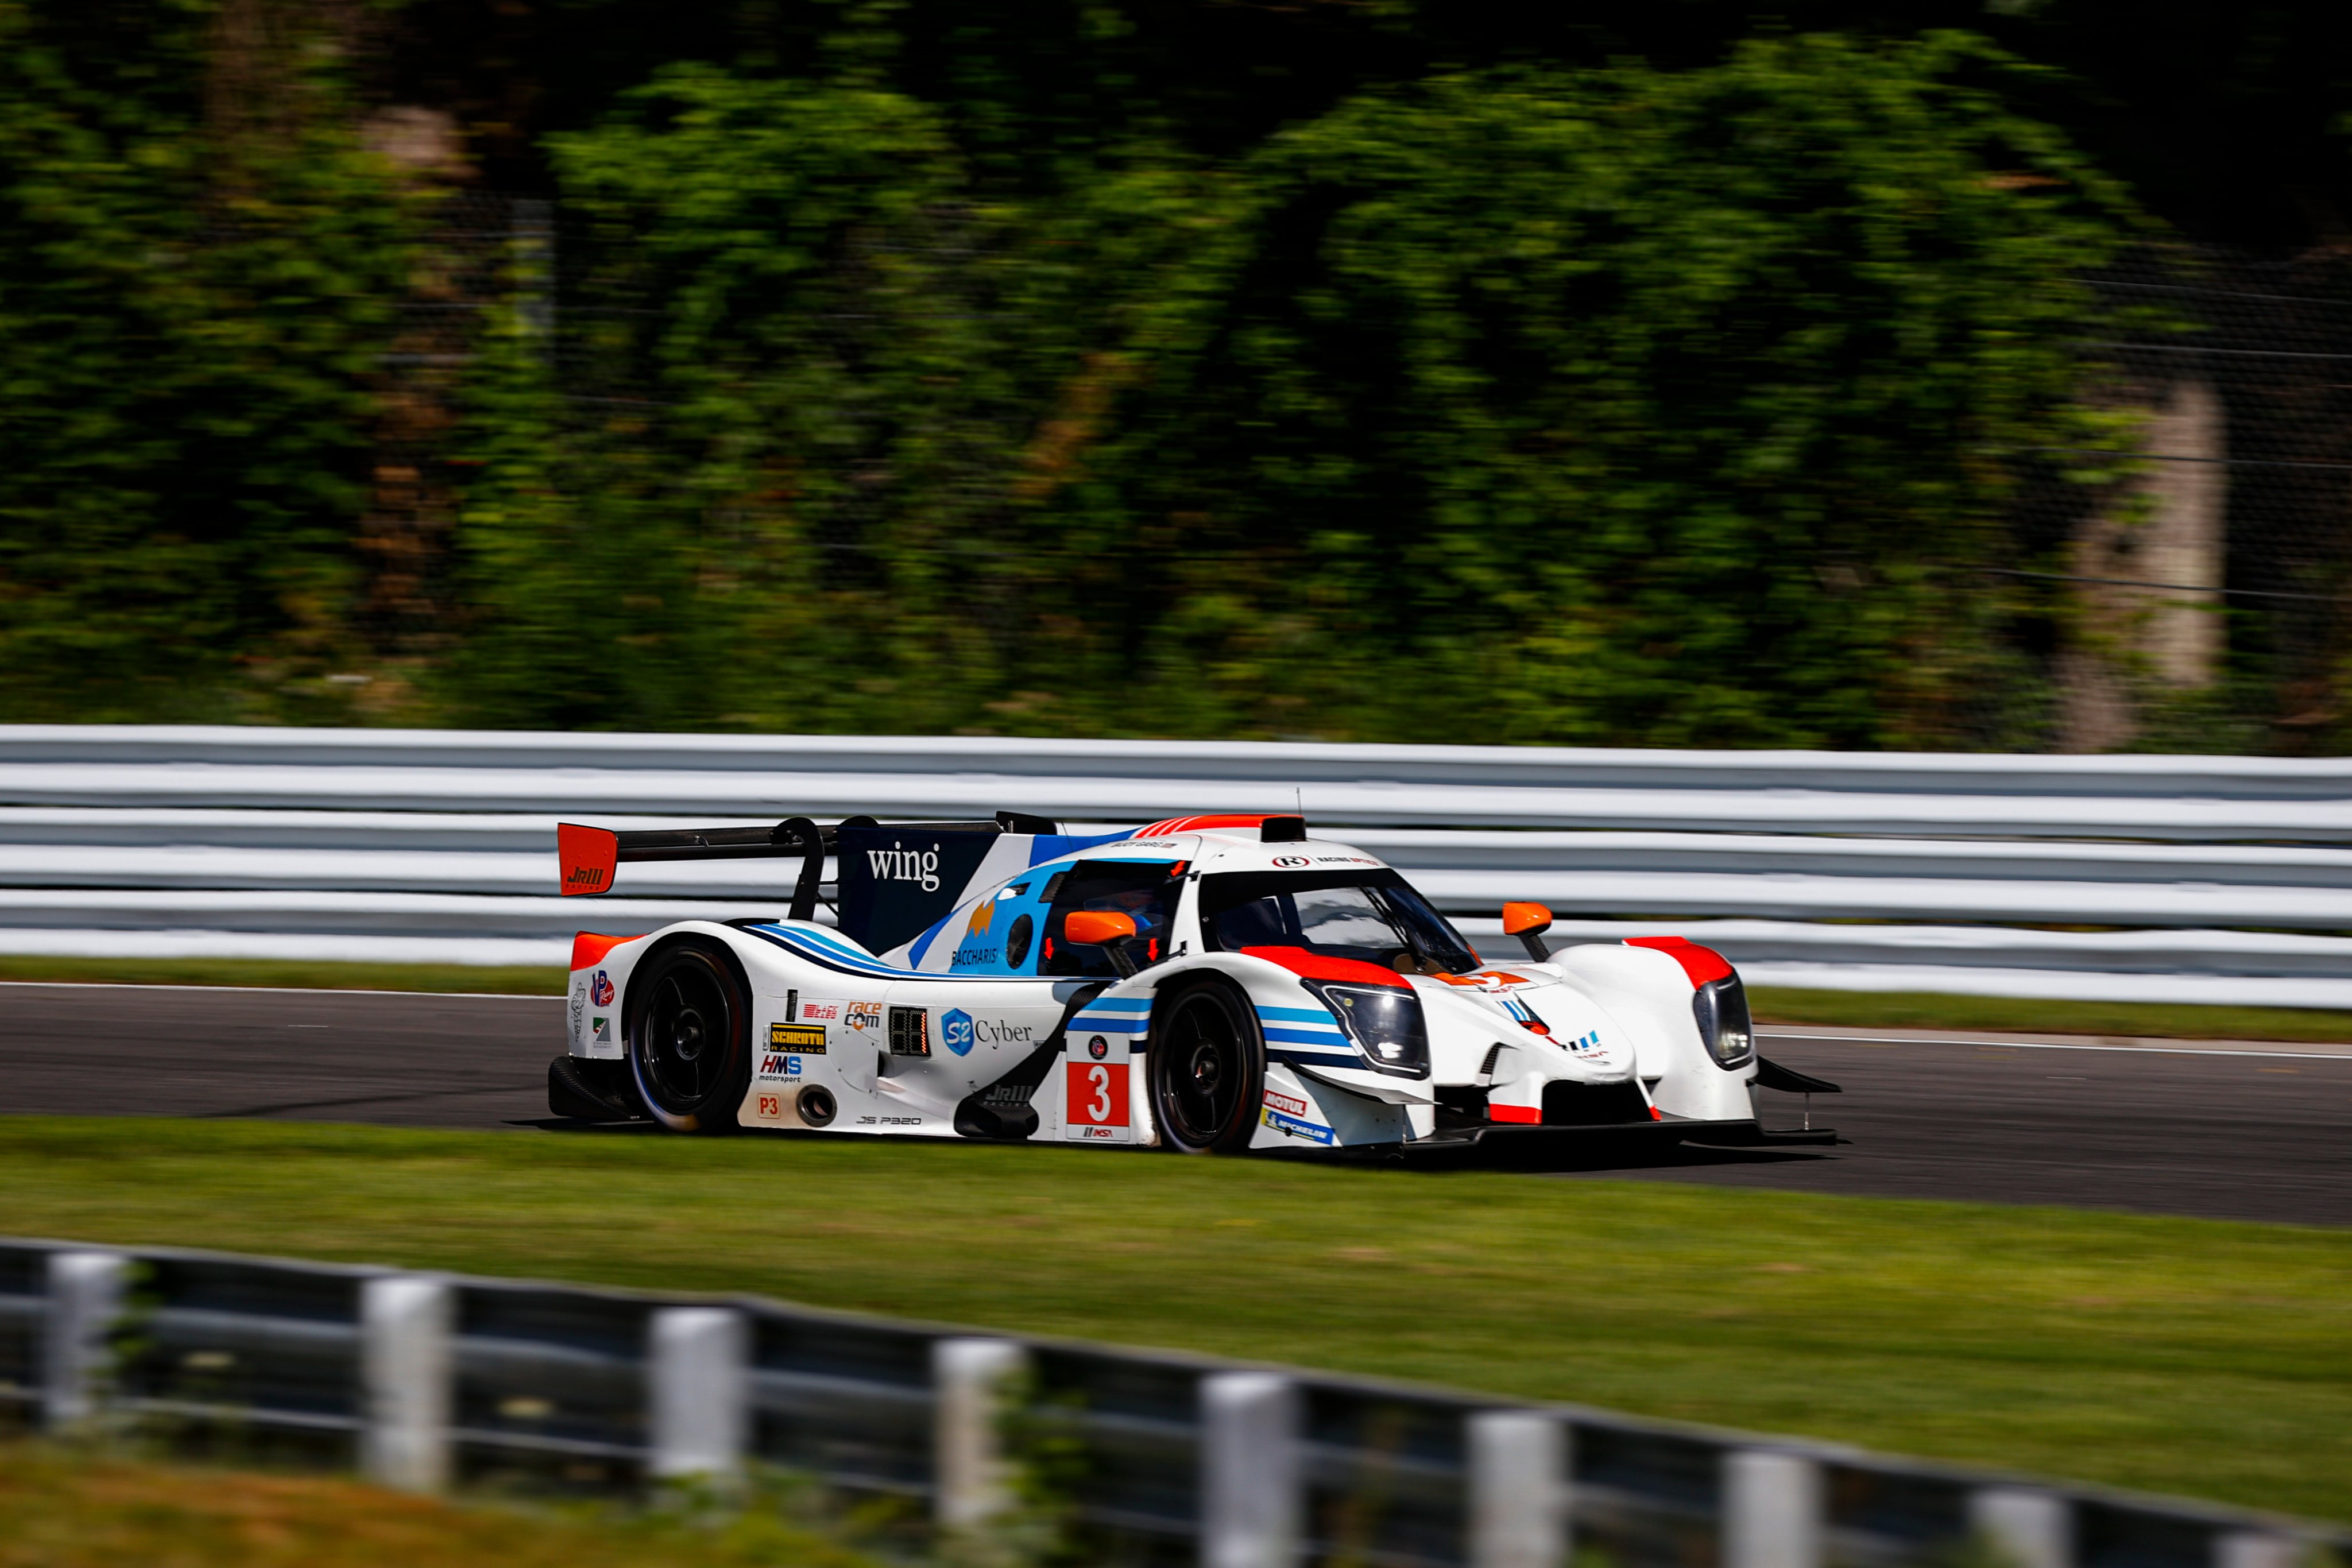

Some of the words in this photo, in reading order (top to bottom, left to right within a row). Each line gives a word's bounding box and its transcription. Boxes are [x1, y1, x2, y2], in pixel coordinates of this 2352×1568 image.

[866, 841, 940, 892] wing
[951, 947, 997, 966] BACCHARIS
[846, 1001, 883, 1015] race
[771, 1031, 825, 1046] SCHROTH
[946, 1021, 972, 1044] S2
[976, 1020, 1033, 1050] Cyber
[771, 1046, 826, 1054] RACING
[760, 1055, 802, 1075] HMS
[759, 1075, 801, 1083] motorsport
[1087, 1065, 1111, 1122] 3
[759, 1097, 778, 1115] P3
[1265, 1092, 1305, 1114] MOTUL
[856, 1116, 877, 1125] JS
[880, 1116, 922, 1125] P320
